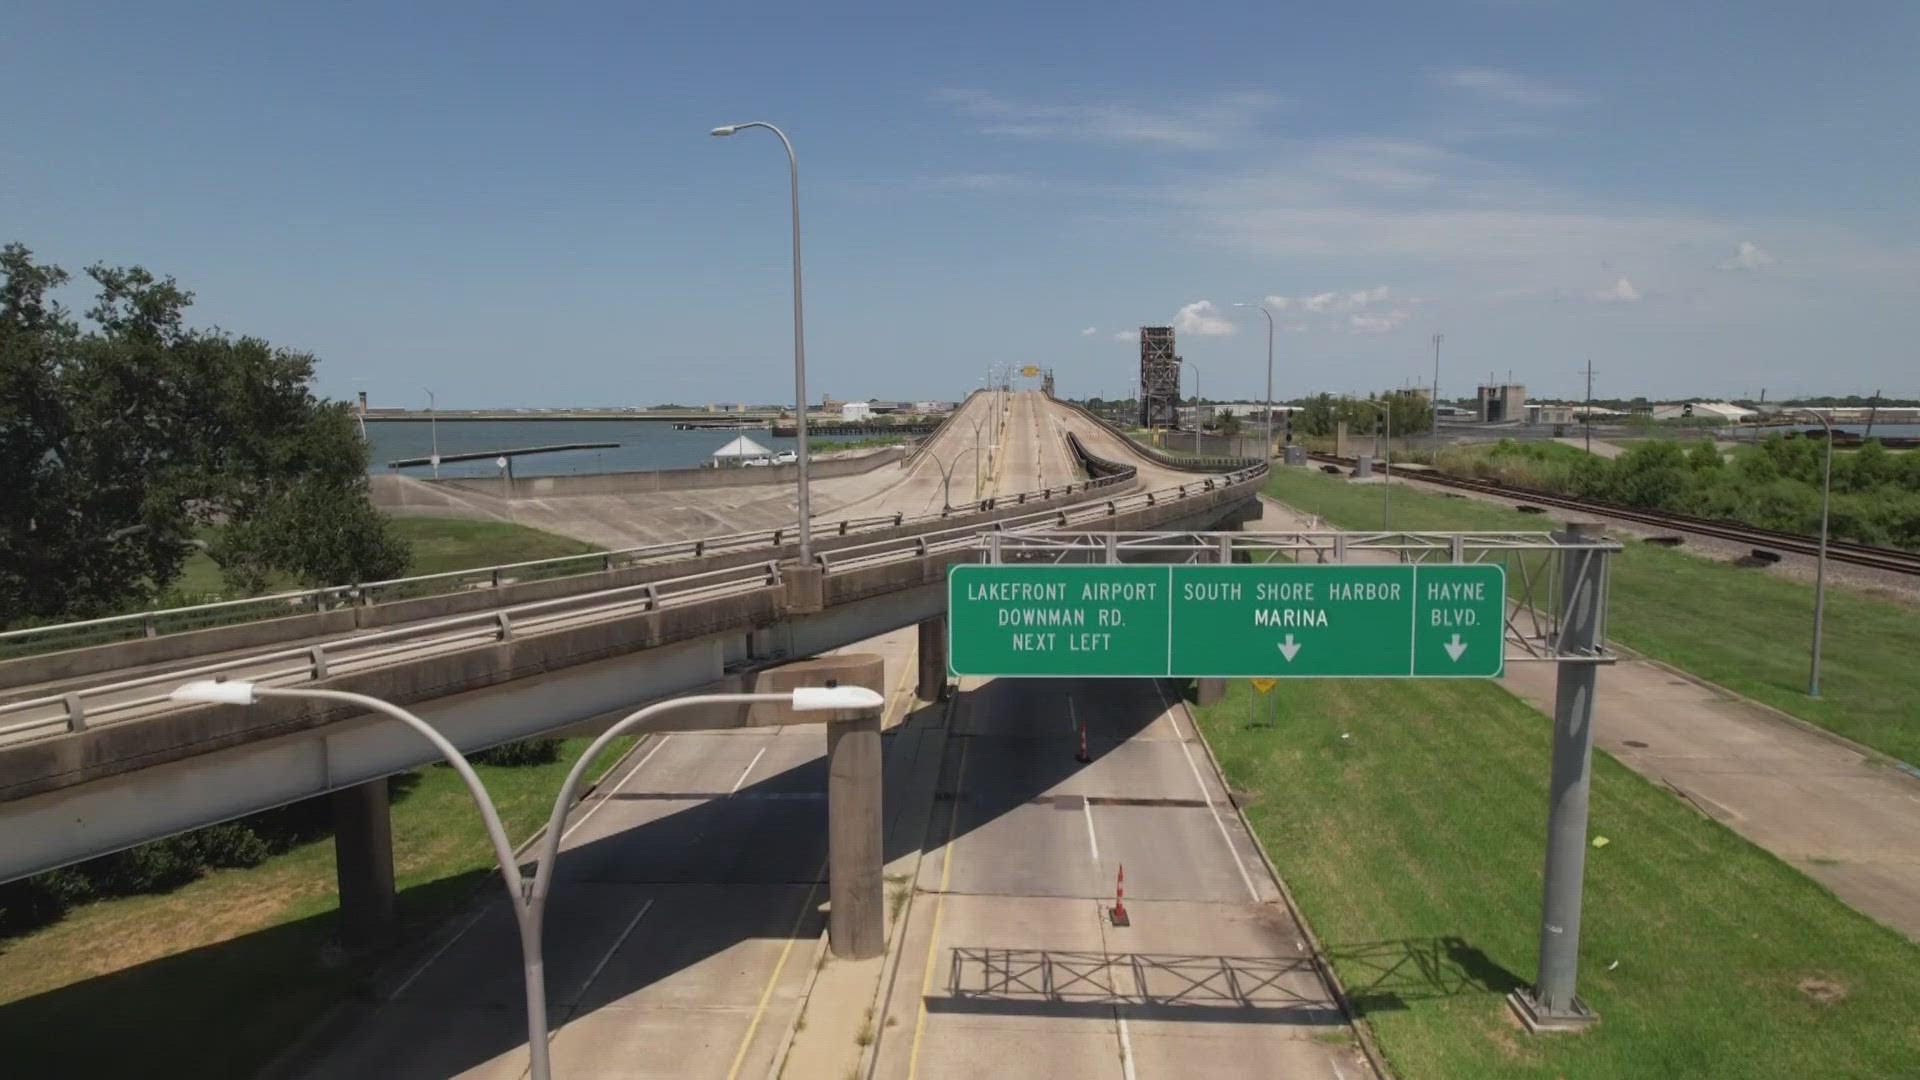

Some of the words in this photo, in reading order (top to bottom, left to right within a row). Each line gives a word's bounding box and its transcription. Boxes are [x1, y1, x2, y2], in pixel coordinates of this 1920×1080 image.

[969, 583, 1065, 600] LAKEFRONT
[1082, 583, 1156, 600] AIRPORT
[1185, 583, 1241, 600] SOUTH
[1257, 583, 1313, 600] SHORE
[1330, 583, 1400, 600] HARBOR
[1429, 583, 1484, 600] HAYNE
[999, 609, 1084, 625] DOWNMAN
[1099, 609, 1125, 626] RD.
[1255, 609, 1328, 626] MARINA
[1431, 609, 1480, 626] BLVD.
[1013, 634, 1055, 650] NEXT
[1071, 634, 1110, 650] LEFT
